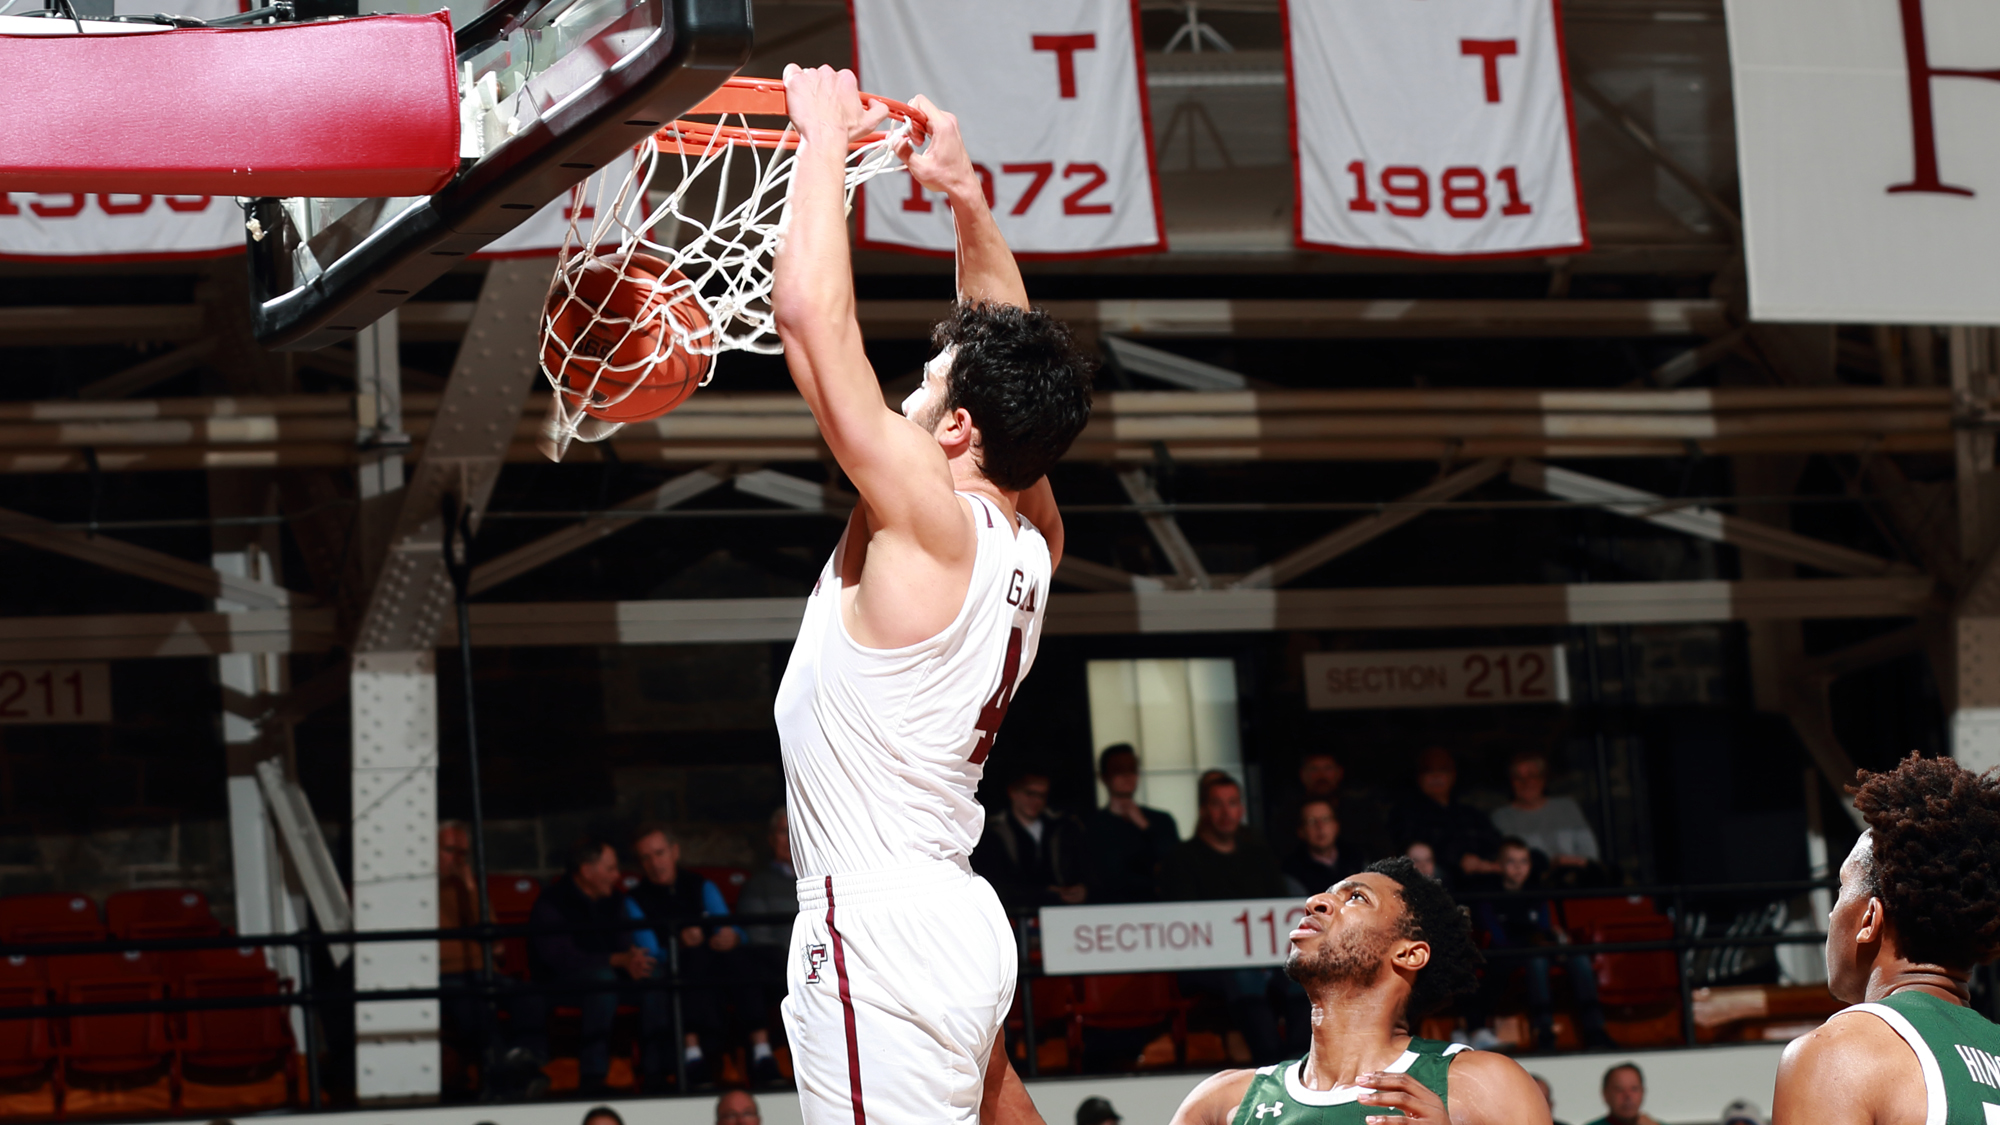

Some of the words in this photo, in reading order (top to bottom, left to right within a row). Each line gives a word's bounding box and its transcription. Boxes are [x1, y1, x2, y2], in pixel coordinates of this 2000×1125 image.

[1032, 33, 1096, 98] T
[1459, 37, 1518, 104] T
[1346, 159, 1533, 219] 1981
[0, 669, 83, 717] 211
[967, 626, 1023, 765] 4
[1326, 664, 1448, 694] SECTION
[1463, 652, 1547, 698] 212
[1073, 921, 1213, 954] SECTION
